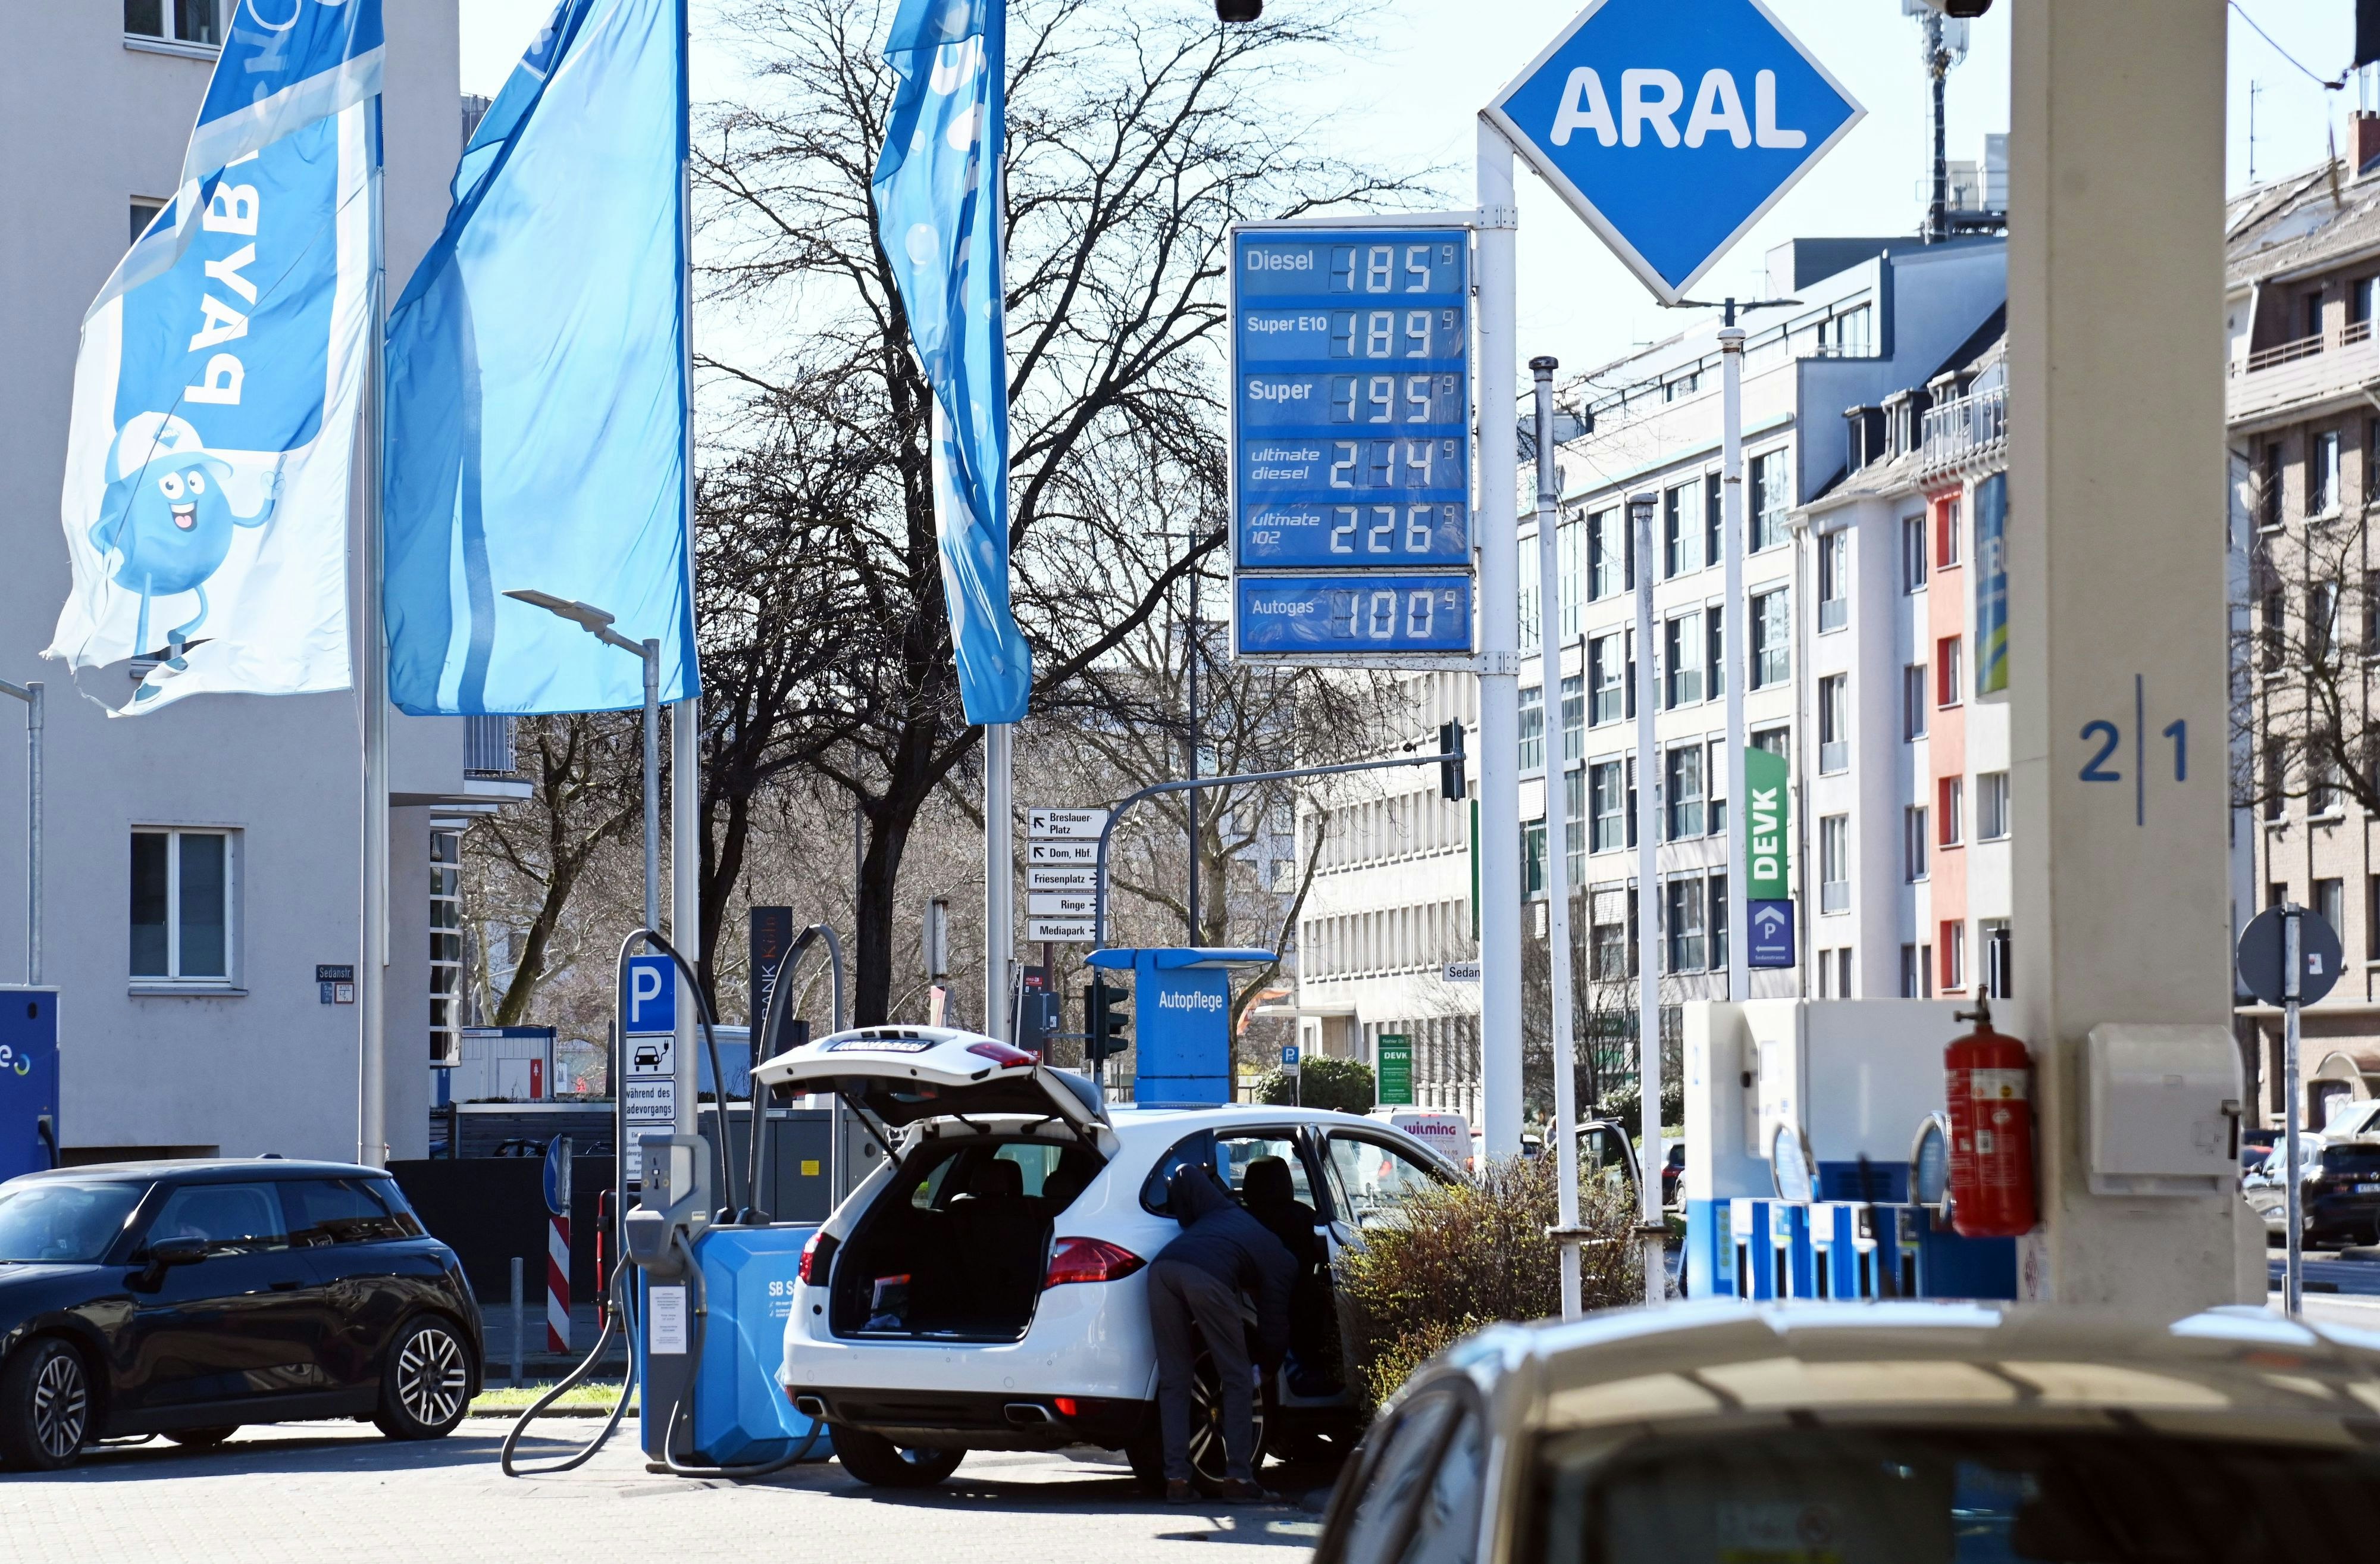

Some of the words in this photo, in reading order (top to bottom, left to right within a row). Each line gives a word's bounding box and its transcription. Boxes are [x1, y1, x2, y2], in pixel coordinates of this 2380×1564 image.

[1549, 66, 1807, 149] ARAL
[1247, 250, 1313, 270] Diesel
[1247, 317, 1295, 334] Super
[1299, 317, 1327, 331] E10
[1248, 381, 1313, 403] Super
[1251, 448, 1320, 461] ultimate
[1252, 467, 1309, 480] diesel
[1252, 513, 1320, 526] ultimate
[1252, 531, 1281, 544] 102
[1252, 600, 1314, 617] Autogas
[2079, 720, 2120, 781] 2
[2162, 719, 2187, 781] 1
[1050, 813, 1092, 822] Breslauer-
[1050, 825, 1070, 834] Platz
[1752, 787, 1778, 880] DEVK
[1050, 848, 1072, 859] Dom,
[1075, 848, 1092, 858] Hbf.
[1035, 874, 1085, 885] Friesenplatz
[1061, 900, 1085, 911] Ringe
[1040, 925, 1085, 938] Mediapark
[1765, 923, 1776, 939] P
[320, 967, 351, 978] Sedanstr.
[632, 966, 662, 1022] P
[1159, 991, 1223, 1012] Autopflege
[1286, 1048, 1295, 1061] P
[658, 1088, 671, 1097] des
[627, 1104, 672, 1116] adevorgangs
[769, 1281, 783, 1297] SB
[786, 1280, 795, 1296] S
